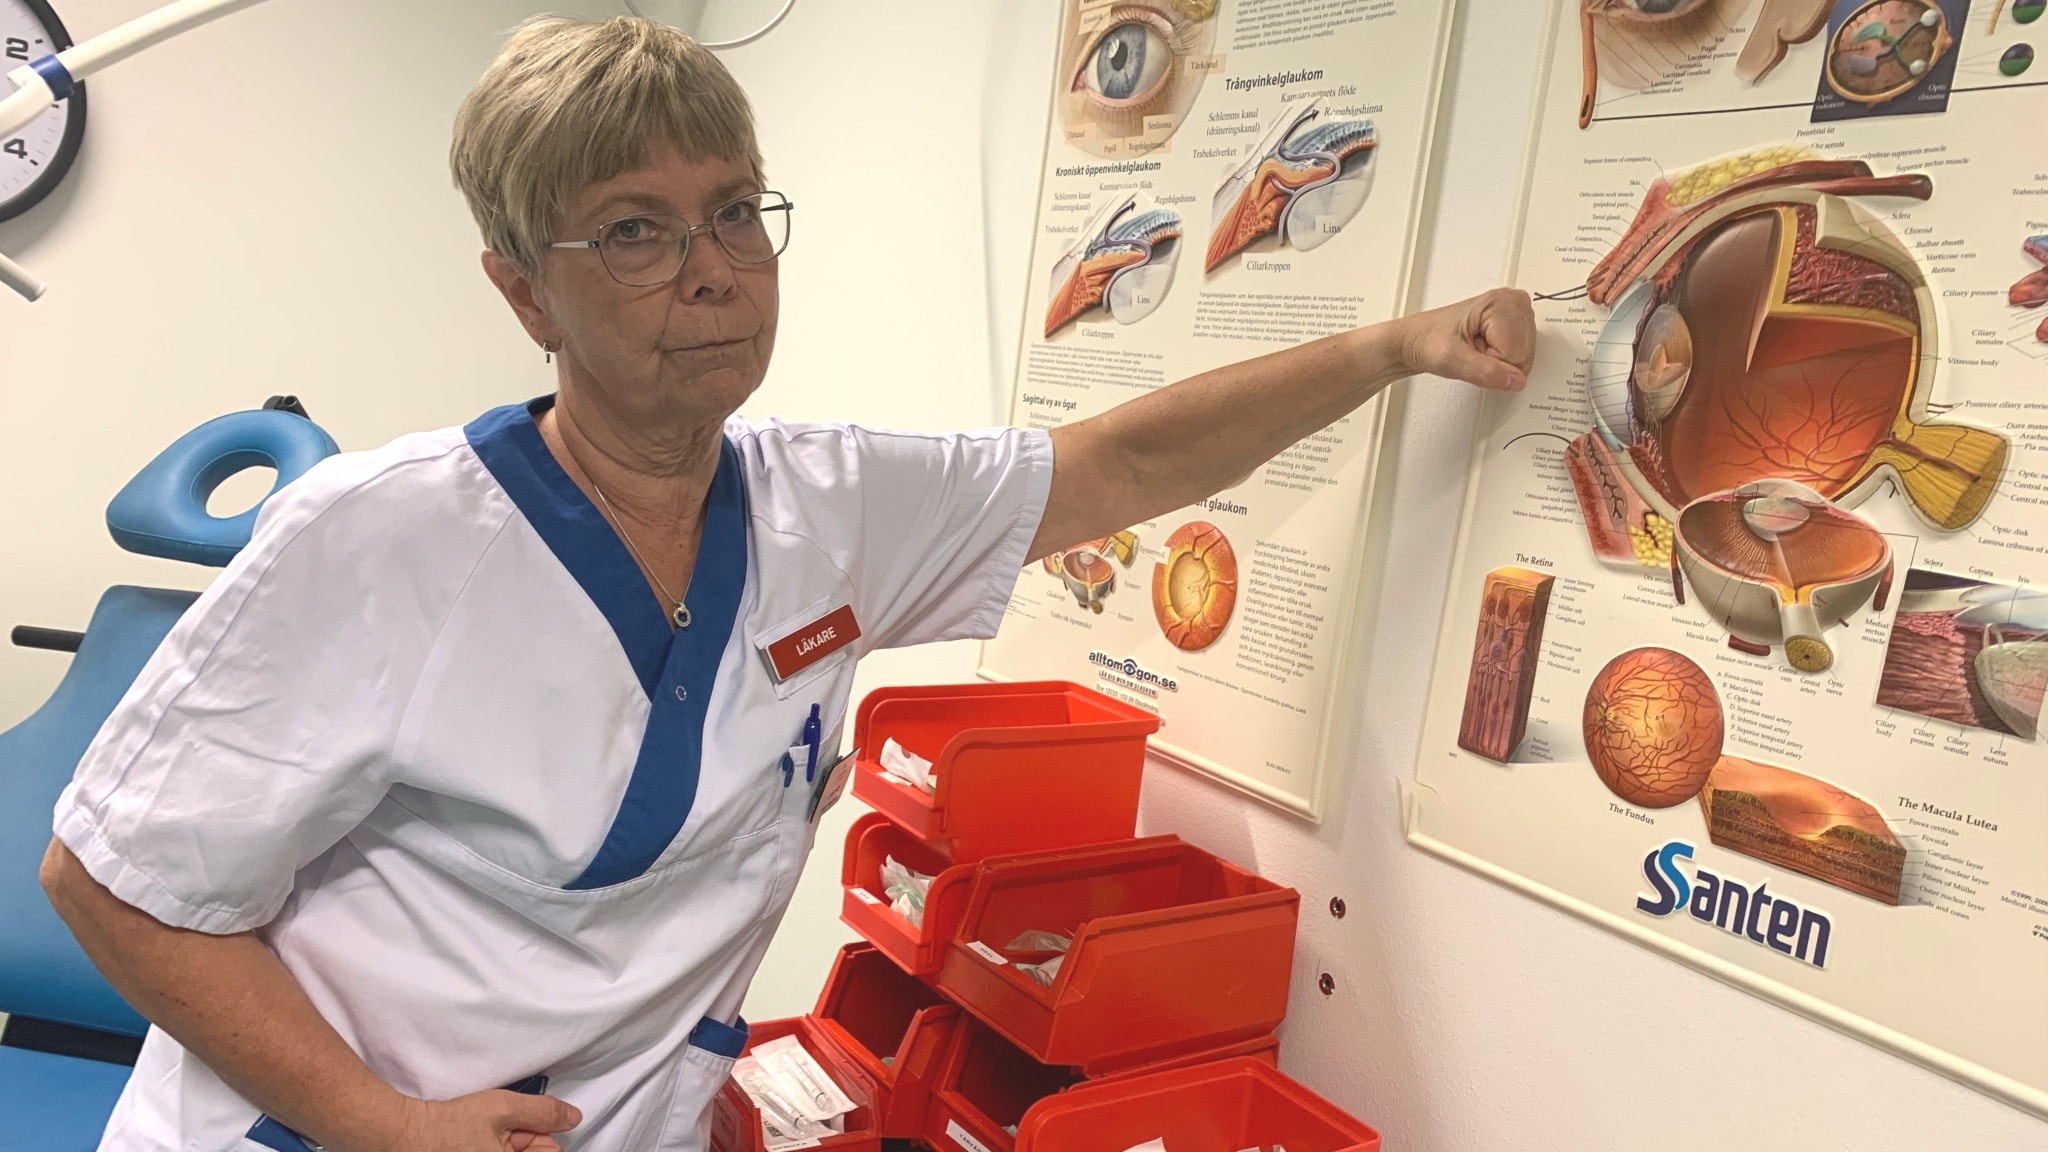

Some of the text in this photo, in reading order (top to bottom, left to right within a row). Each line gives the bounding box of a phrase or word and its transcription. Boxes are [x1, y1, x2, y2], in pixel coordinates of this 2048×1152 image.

[1226, 68, 1323, 92] Trångvinkelglaukom
[1338, 85, 1357, 96] flöde
[1208, 108, 1258, 122] Schlemms kanal
[1827, 126, 1835, 134] fat
[4, 138, 28, 159] 4
[1055, 161, 1161, 177] Kroniskt öppenvinkelglaukom
[1896, 157, 1969, 173] Superior rectus muscle
[1891, 211, 1911, 220] Sclera
[1323, 223, 1342, 234] Lins
[1904, 226, 1933, 235] Choroid
[1916, 240, 1939, 248] Bulbar
[1246, 261, 1291, 273] Ciliarkroppen
[1932, 266, 1955, 274] Retina
[1137, 295, 1150, 304] Lins
[1972, 329, 1997, 337] Ciliary
[1948, 358, 1999, 367] Vitreous body
[1023, 394, 1046, 405] Sagittal
[1046, 398, 1053, 407] vy
[1063, 399, 1077, 411] ögat
[1966, 400, 2022, 410] Posterior ciliary
[1312, 444, 1332, 453] uppstår
[1266, 468, 1311, 481] dräneringskanaler
[1312, 476, 1327, 484] under
[1209, 498, 1248, 516] glaukom
[1992, 525, 2029, 536] Optic disk
[1256, 540, 1280, 550] Sekundärt
[1281, 545, 1301, 554] glaukom
[1978, 537, 2004, 548] Lamina
[2006, 541, 2033, 552] cribrosa
[1286, 556, 1309, 567] beroende
[1316, 563, 1330, 572] andra
[1516, 553, 1554, 567] The Retina
[1924, 558, 1944, 568] Sclera
[1968, 566, 1994, 577] Cornea
[2017, 575, 2030, 584] Iris
[1622, 594, 1674, 610] Lateral rectus muscle
[1865, 618, 1889, 629] Medial
[1686, 631, 1704, 641] Macula
[1865, 627, 1885, 637] rectus
[796, 626, 837, 656] LÄKARE
[1861, 634, 1886, 645] muscle
[1715, 654, 1773, 671] Inferior rectus muscle
[1724, 672, 1740, 682] Fovea
[1741, 676, 1763, 686] centralis
[1800, 677, 1820, 688] Central
[1828, 678, 1844, 688] Optic
[1729, 683, 1748, 693] Macula
[1750, 688, 1763, 697] lutea
[1800, 686, 1817, 696] artery
[1826, 688, 1843, 696] nerve
[1734, 695, 1748, 704] Optic
[1737, 705, 1760, 716] Superior
[1761, 711, 1775, 720] nasal
[1776, 716, 1792, 725] artery
[1737, 715, 1758, 726] Inferior
[1759, 721, 1773, 730] nasal
[1774, 725, 1790, 736] artery
[1875, 719, 1897, 730] Ciliary
[1737, 725, 1760, 737] Superior
[1760, 732, 1786, 745] temporal
[1787, 740, 1803, 750] artery
[1876, 727, 1893, 738] body
[1913, 727, 1936, 739] Ciliary
[1910, 737, 1935, 748] process
[1946, 735, 1970, 748] Ciliary
[1738, 736, 1759, 747] Inferior
[1760, 742, 1785, 755] temporal
[1785, 750, 1802, 761] artery
[1943, 746, 1969, 757] zonules
[1990, 746, 2007, 757] Lens
[1983, 756, 2009, 767] sutures
[1608, 802, 1655, 826] The Fundus
[1898, 796, 1998, 831] The Macula Lutea
[1909, 818, 1959, 837] Fovea centralis
[1922, 834, 1949, 847] Foveola
[1927, 849, 1984, 871] Ganglionic layer
[1925, 861, 1989, 886] Inner nuclear layer
[1922, 872, 1976, 895] Fibers of Müller
[1636, 841, 1831, 968] Santen
[1919, 885, 1985, 912] Outer nuclear layer
[1917, 897, 1970, 920] Rods and cones
